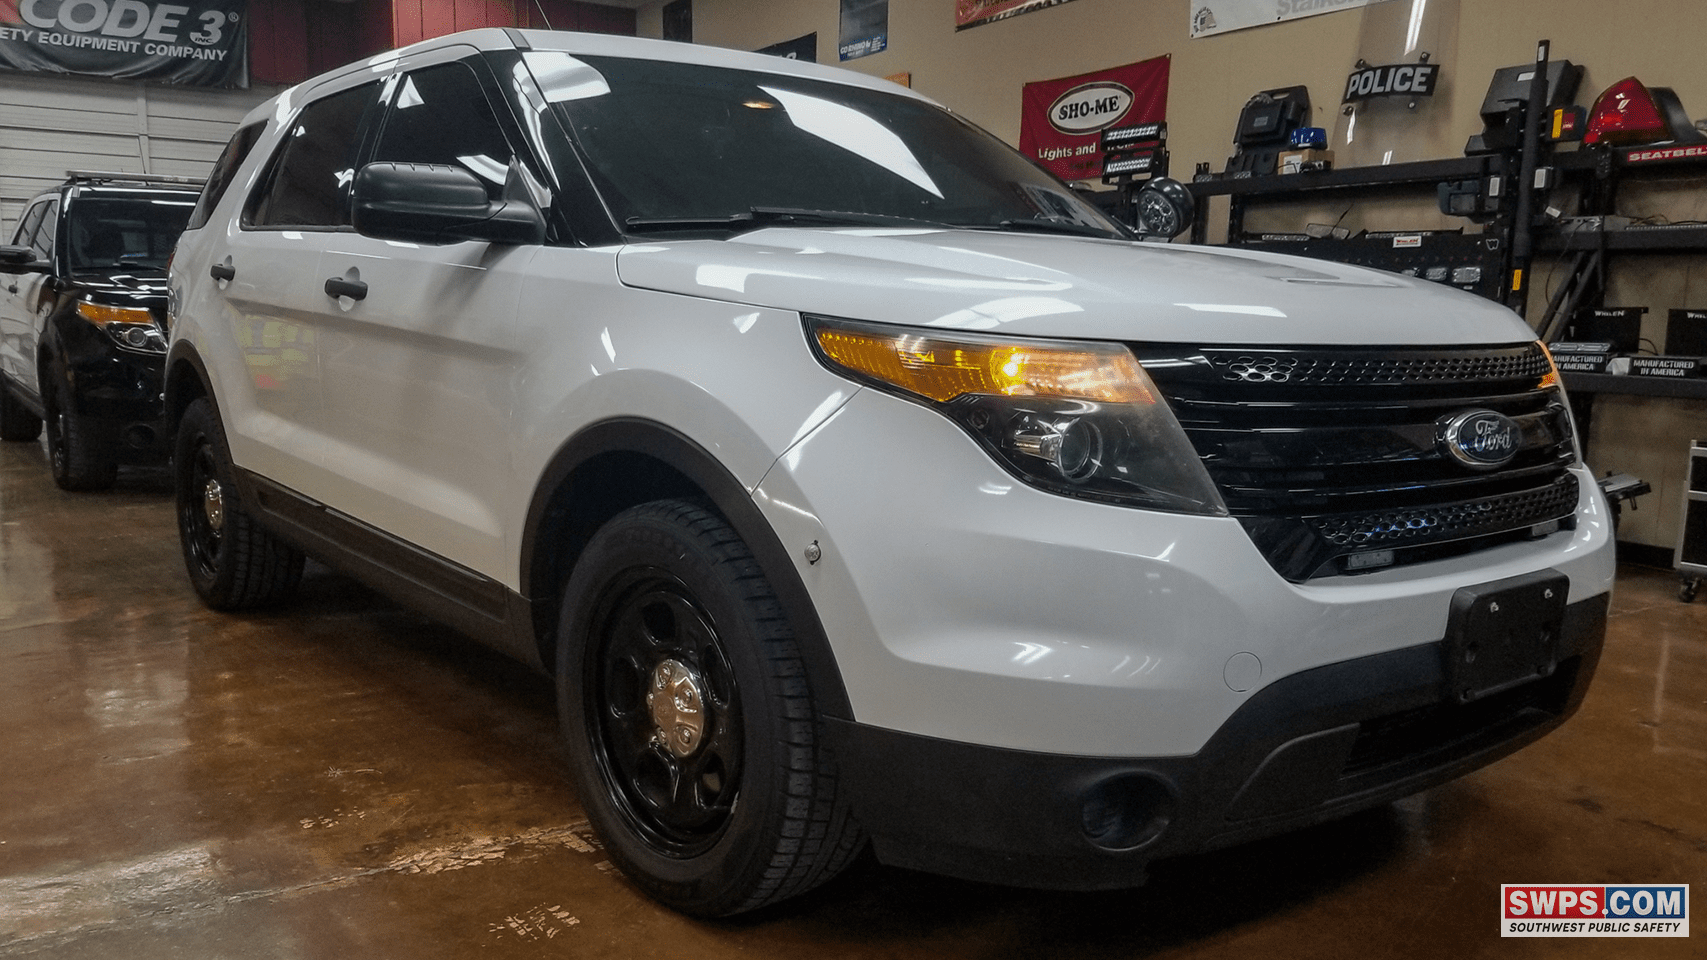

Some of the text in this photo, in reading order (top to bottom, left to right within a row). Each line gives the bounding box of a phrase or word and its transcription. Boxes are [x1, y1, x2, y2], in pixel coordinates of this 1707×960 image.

[19, 0, 226, 45] CODE 3
[38, 31, 140, 54] EQUIPMENT
[144, 43, 228, 61] COMPANY
[1346, 66, 1431, 99] POLICE
[1058, 95, 1120, 120] SHO-ME
[1038, 146, 1073, 161] Lights
[1075, 142, 1097, 157] and
[1628, 147, 1707, 162] SEATBEL
[1552, 355, 1603, 364] ANUFACTURED
[1633, 360, 1694, 369] MANUFACTURED
[1650, 368, 1685, 377] AMERICA
[1474, 419, 1512, 452] Ford
